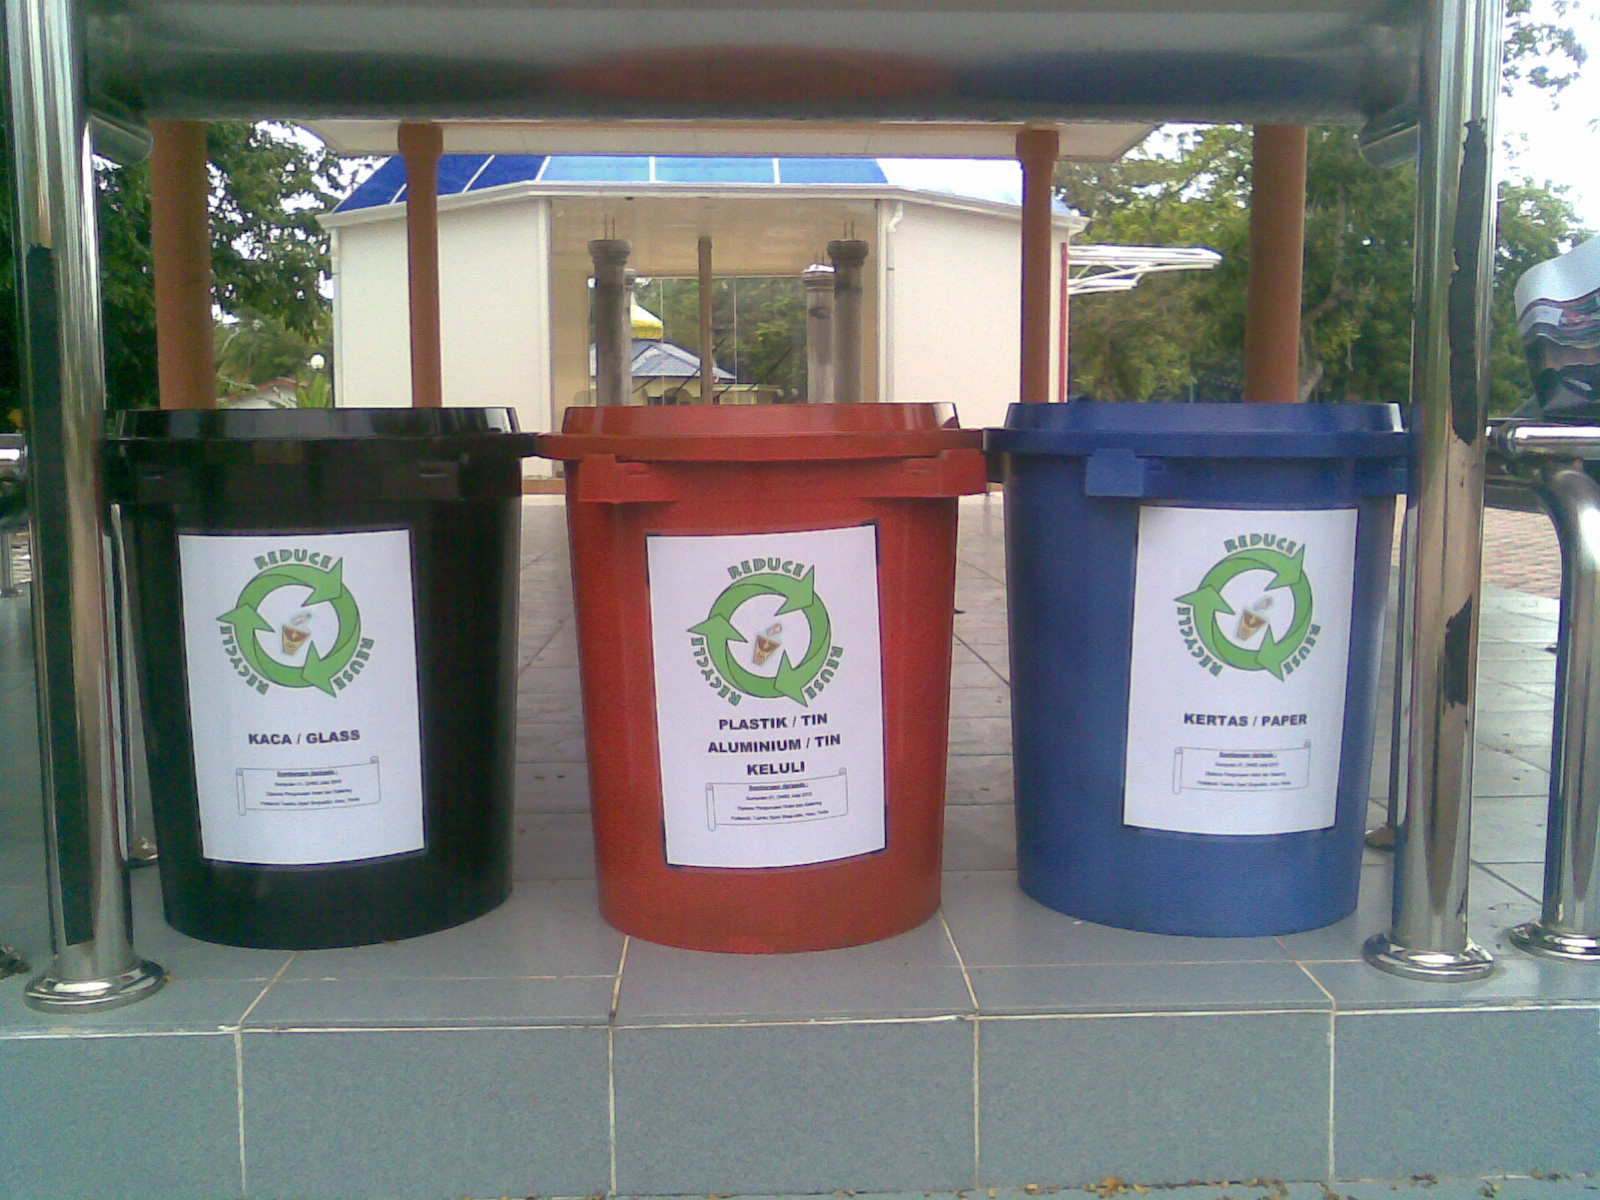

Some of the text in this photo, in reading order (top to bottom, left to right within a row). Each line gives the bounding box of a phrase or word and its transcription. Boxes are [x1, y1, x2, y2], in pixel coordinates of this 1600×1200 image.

[1223, 533, 1296, 555] REDUCE
[254, 549, 333, 570] REDUCE
[727, 557, 804, 580] REDUCE
[1177, 606, 1223, 677] RECYCLE
[1283, 623, 1321, 674] REUSE
[220, 625, 269, 695] RECYCLE
[333, 637, 375, 690] REUSE
[691, 637, 742, 706] RECYCLE
[804, 645, 844, 699] REUSE
[719, 717, 788, 730] PLASTIK
[801, 713, 828, 726] TIN
[1184, 713, 1248, 727] KERTAS
[1262, 713, 1308, 727] PAPER
[248, 733, 292, 745] KACA
[306, 729, 361, 744] GLASS
[708, 738, 801, 753] ALUMINIUM
[814, 733, 841, 747] TIN
[747, 761, 805, 776] KELULI
